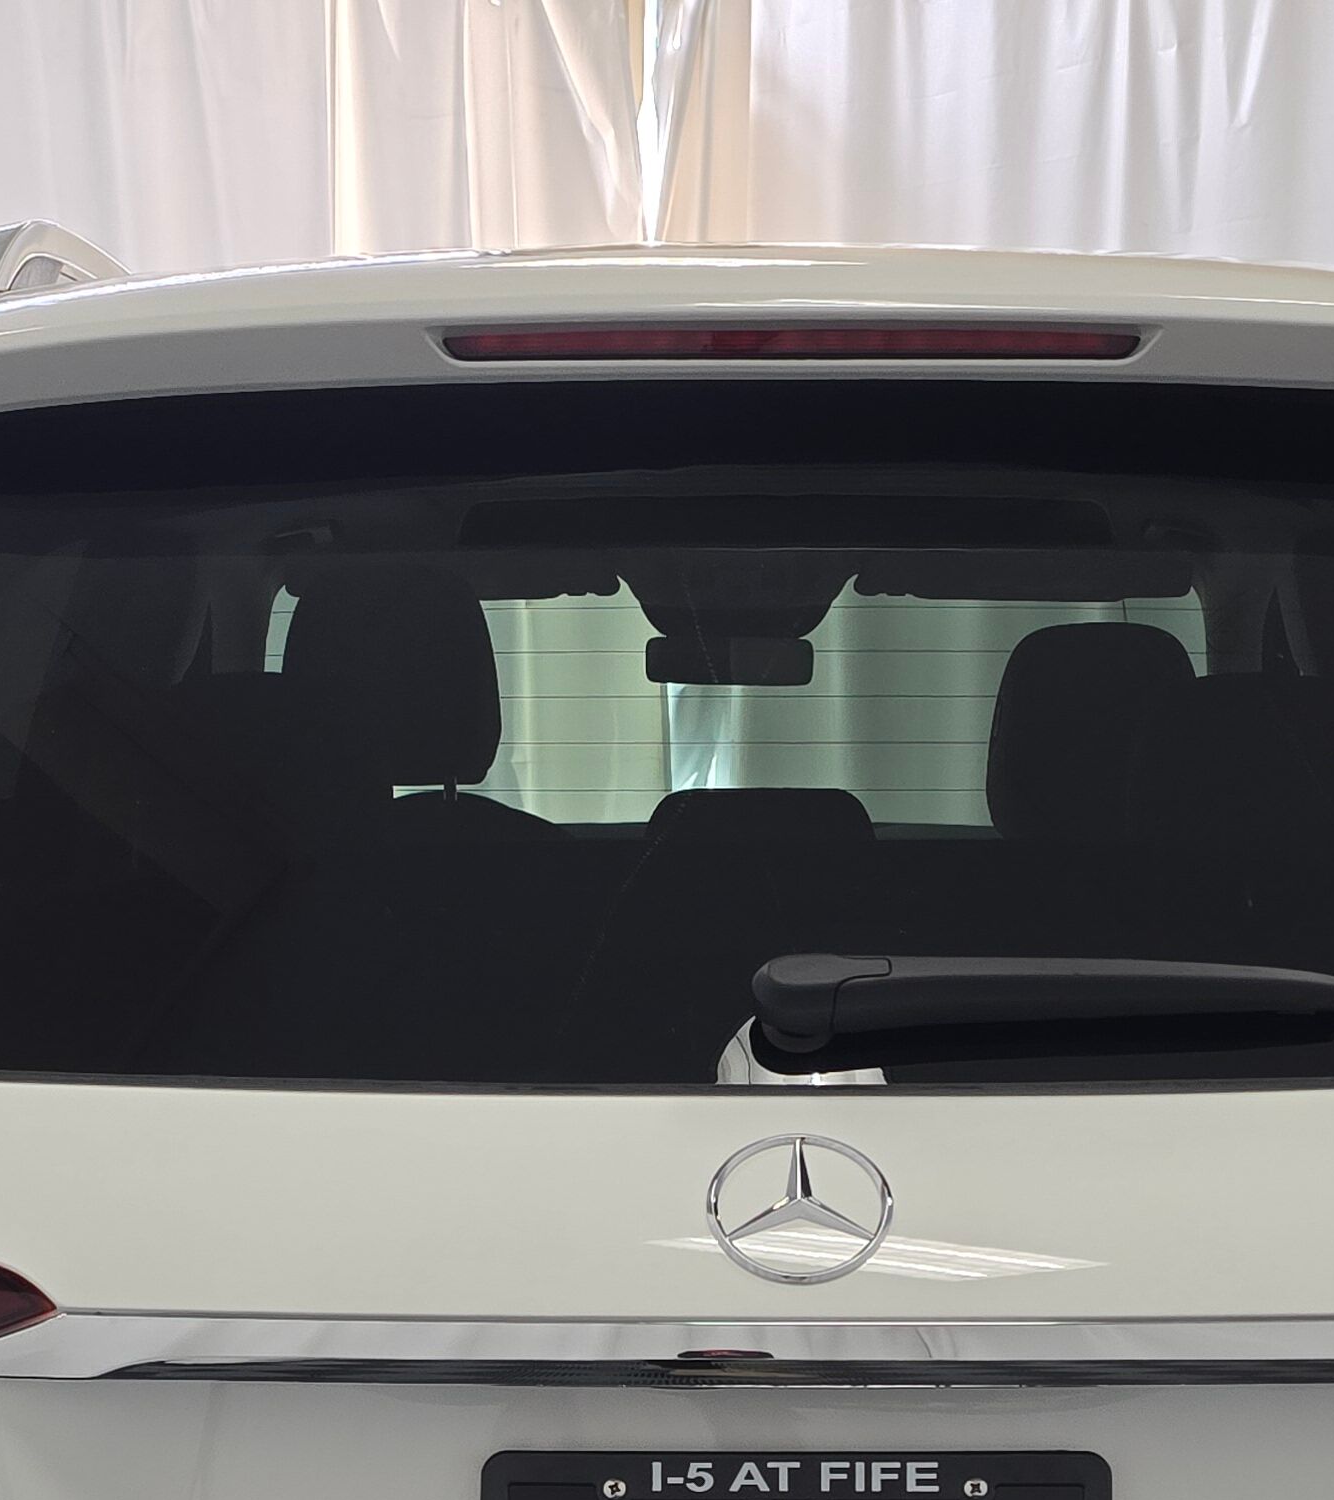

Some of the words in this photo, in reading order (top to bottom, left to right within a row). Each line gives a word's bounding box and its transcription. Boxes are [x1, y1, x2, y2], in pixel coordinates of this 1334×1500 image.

[651, 1461, 714, 1493] I-5
[729, 1461, 801, 1492] AT
[820, 1461, 940, 1493] FIFE
